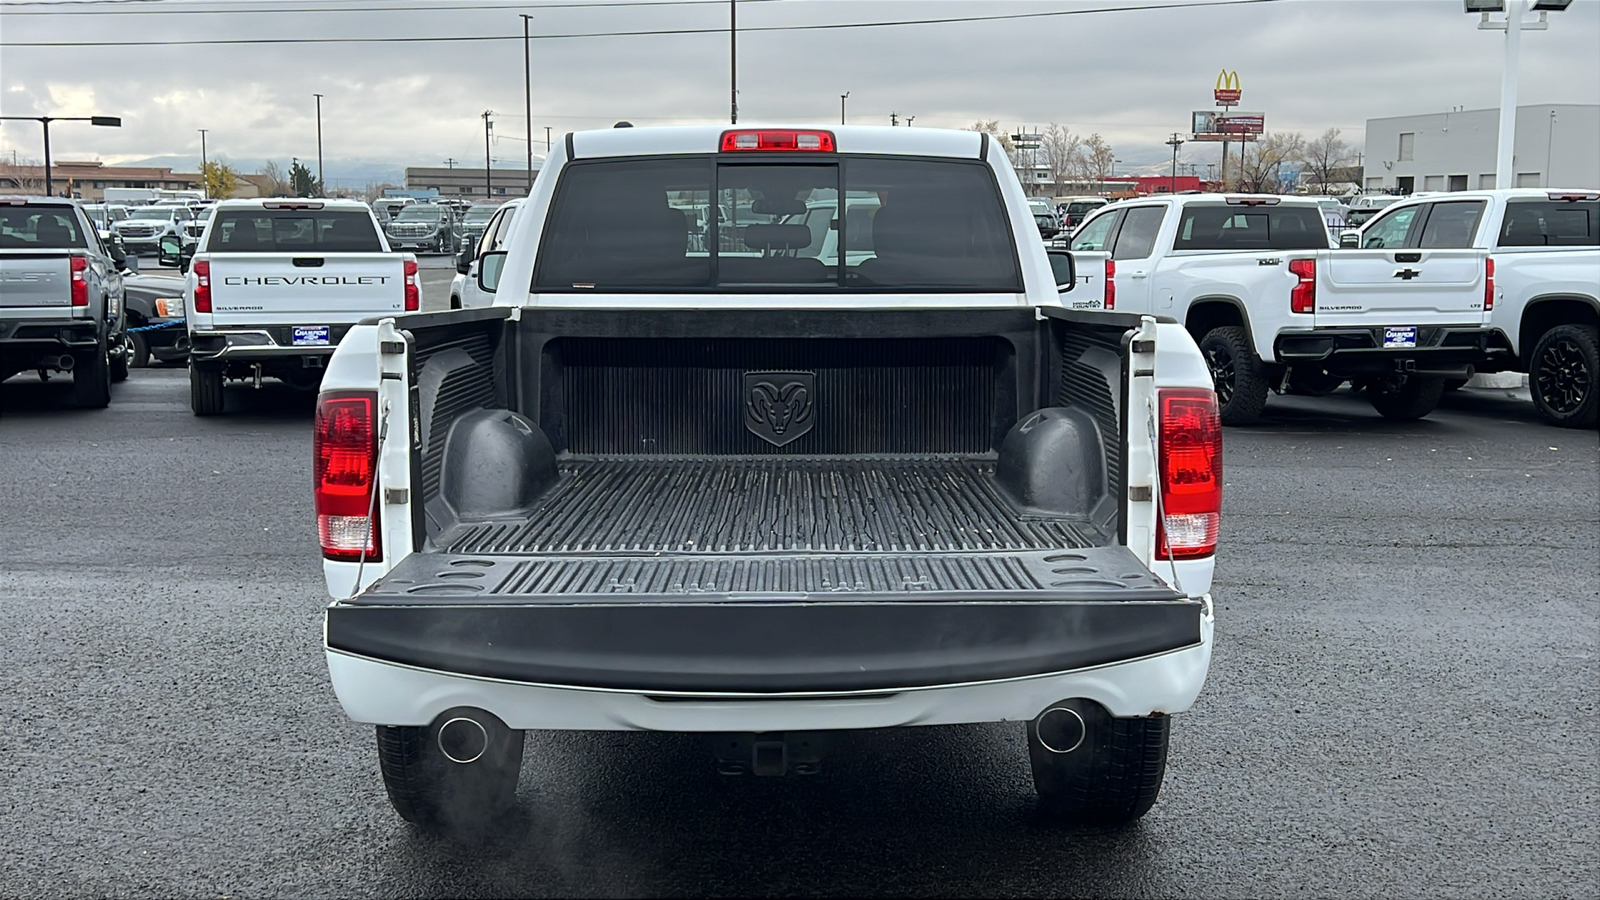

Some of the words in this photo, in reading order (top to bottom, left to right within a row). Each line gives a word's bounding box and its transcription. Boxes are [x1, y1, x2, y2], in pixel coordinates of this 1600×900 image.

[224, 276, 391, 285] CHEVROLET
[294, 329, 328, 337] CHAMPION
[1385, 330, 1415, 338] CHAMPION
